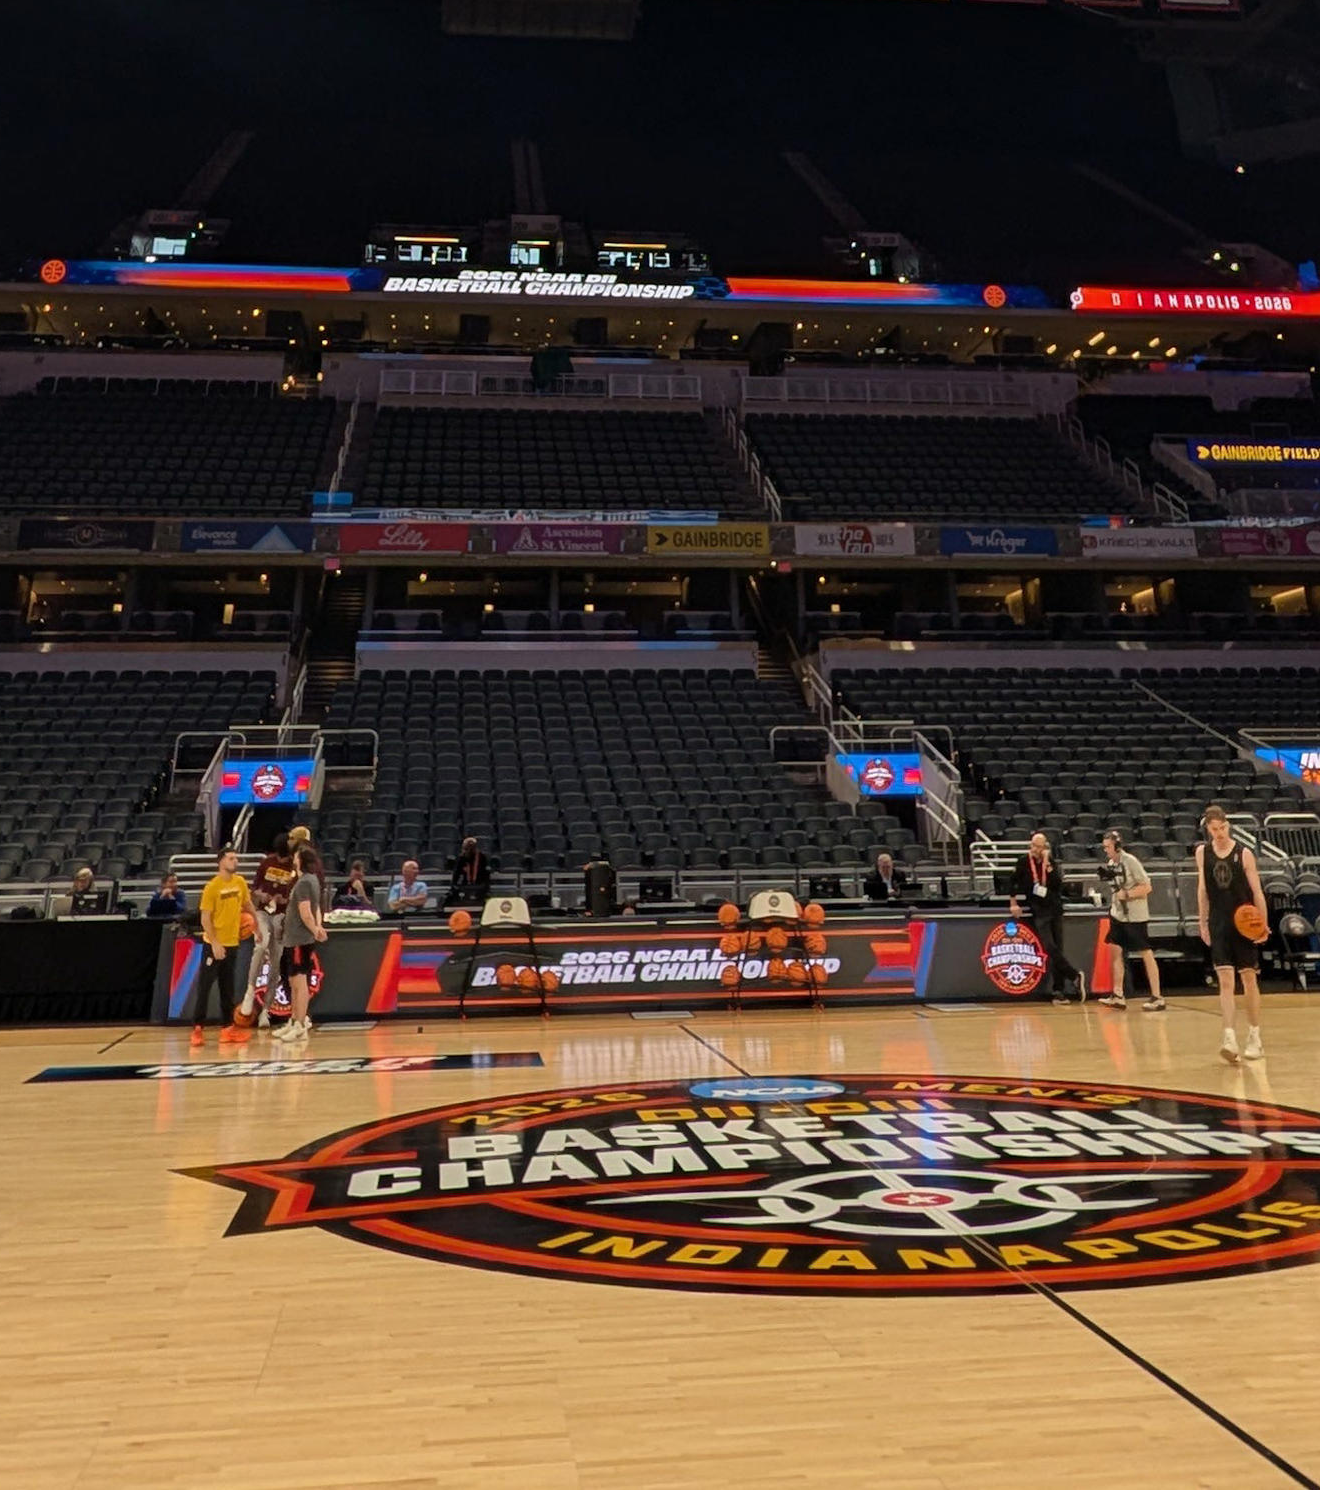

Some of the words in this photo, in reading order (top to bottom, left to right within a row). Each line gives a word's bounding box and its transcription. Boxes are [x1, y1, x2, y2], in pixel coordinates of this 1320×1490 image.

[384, 277, 528, 294] BASKETBALL
[529, 281, 694, 299] CHAMPIONSHIP
[1254, 296, 1292, 311] 2026
[1211, 444, 1282, 461] GAINBRIDGE
[378, 524, 429, 549] Lilly
[542, 528, 603, 538] Ascension
[673, 531, 763, 548] GAINBRIDGE
[986, 529, 1027, 554] Kroger
[542, 540, 560, 551] St.
[562, 540, 604, 551] Vincent
[561, 949, 631, 965] 2026
[634, 948, 708, 963] NCAA
[711, 1086, 842, 1099] NCAA
[892, 1080, 1141, 1106] MEN'S
[448, 1092, 648, 1126] 2026
[448, 1110, 1209, 1160] BASKETBALL
